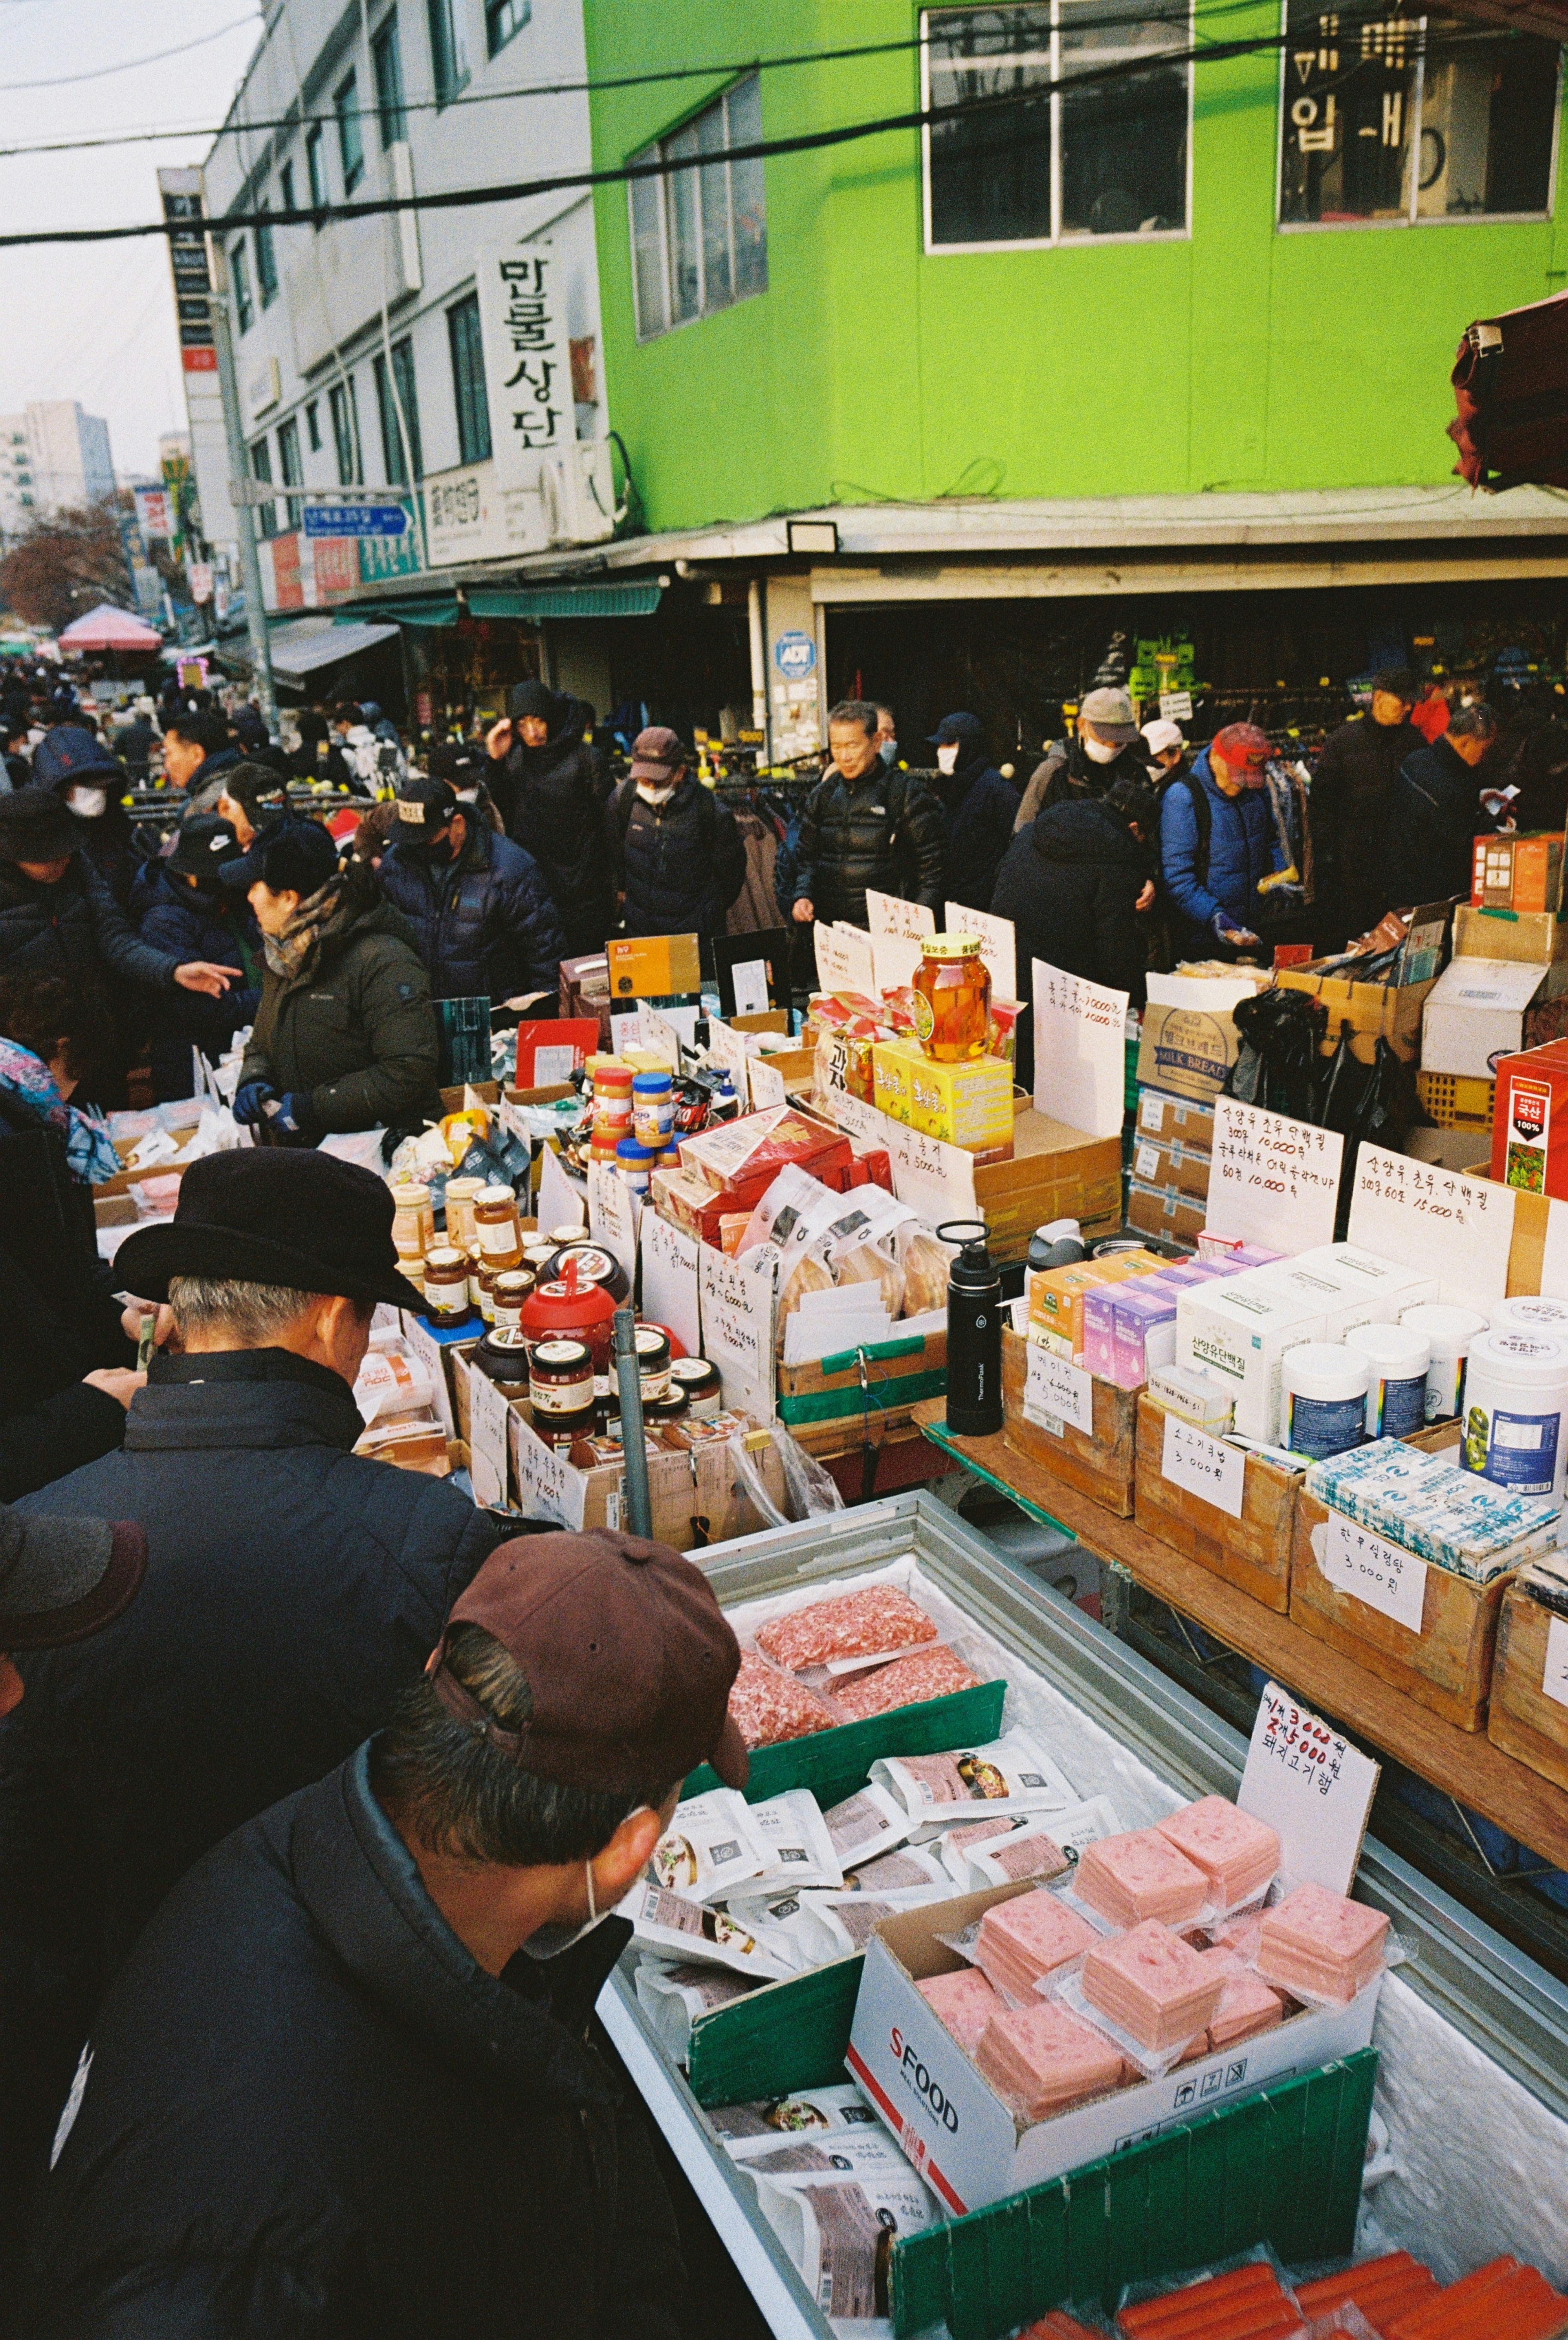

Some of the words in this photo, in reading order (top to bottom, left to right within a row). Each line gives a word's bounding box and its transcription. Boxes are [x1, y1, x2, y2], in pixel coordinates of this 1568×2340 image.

[499, 258, 562, 449] 만물상단
[781, 645, 810, 665] ADT
[1159, 1051, 1185, 1065] MILK
[1187, 1055, 1227, 1078] BREAD
[1517, 1120, 1540, 1132] 100%
[1518, 1103, 1541, 1120] 국산
[1192, 1336, 1245, 1372] 산양유단백질
[889, 2027, 959, 2134] SFOOD
[900, 2069, 912, 2089] MEAL
[913, 2088, 939, 2126] SOLUTIONS
